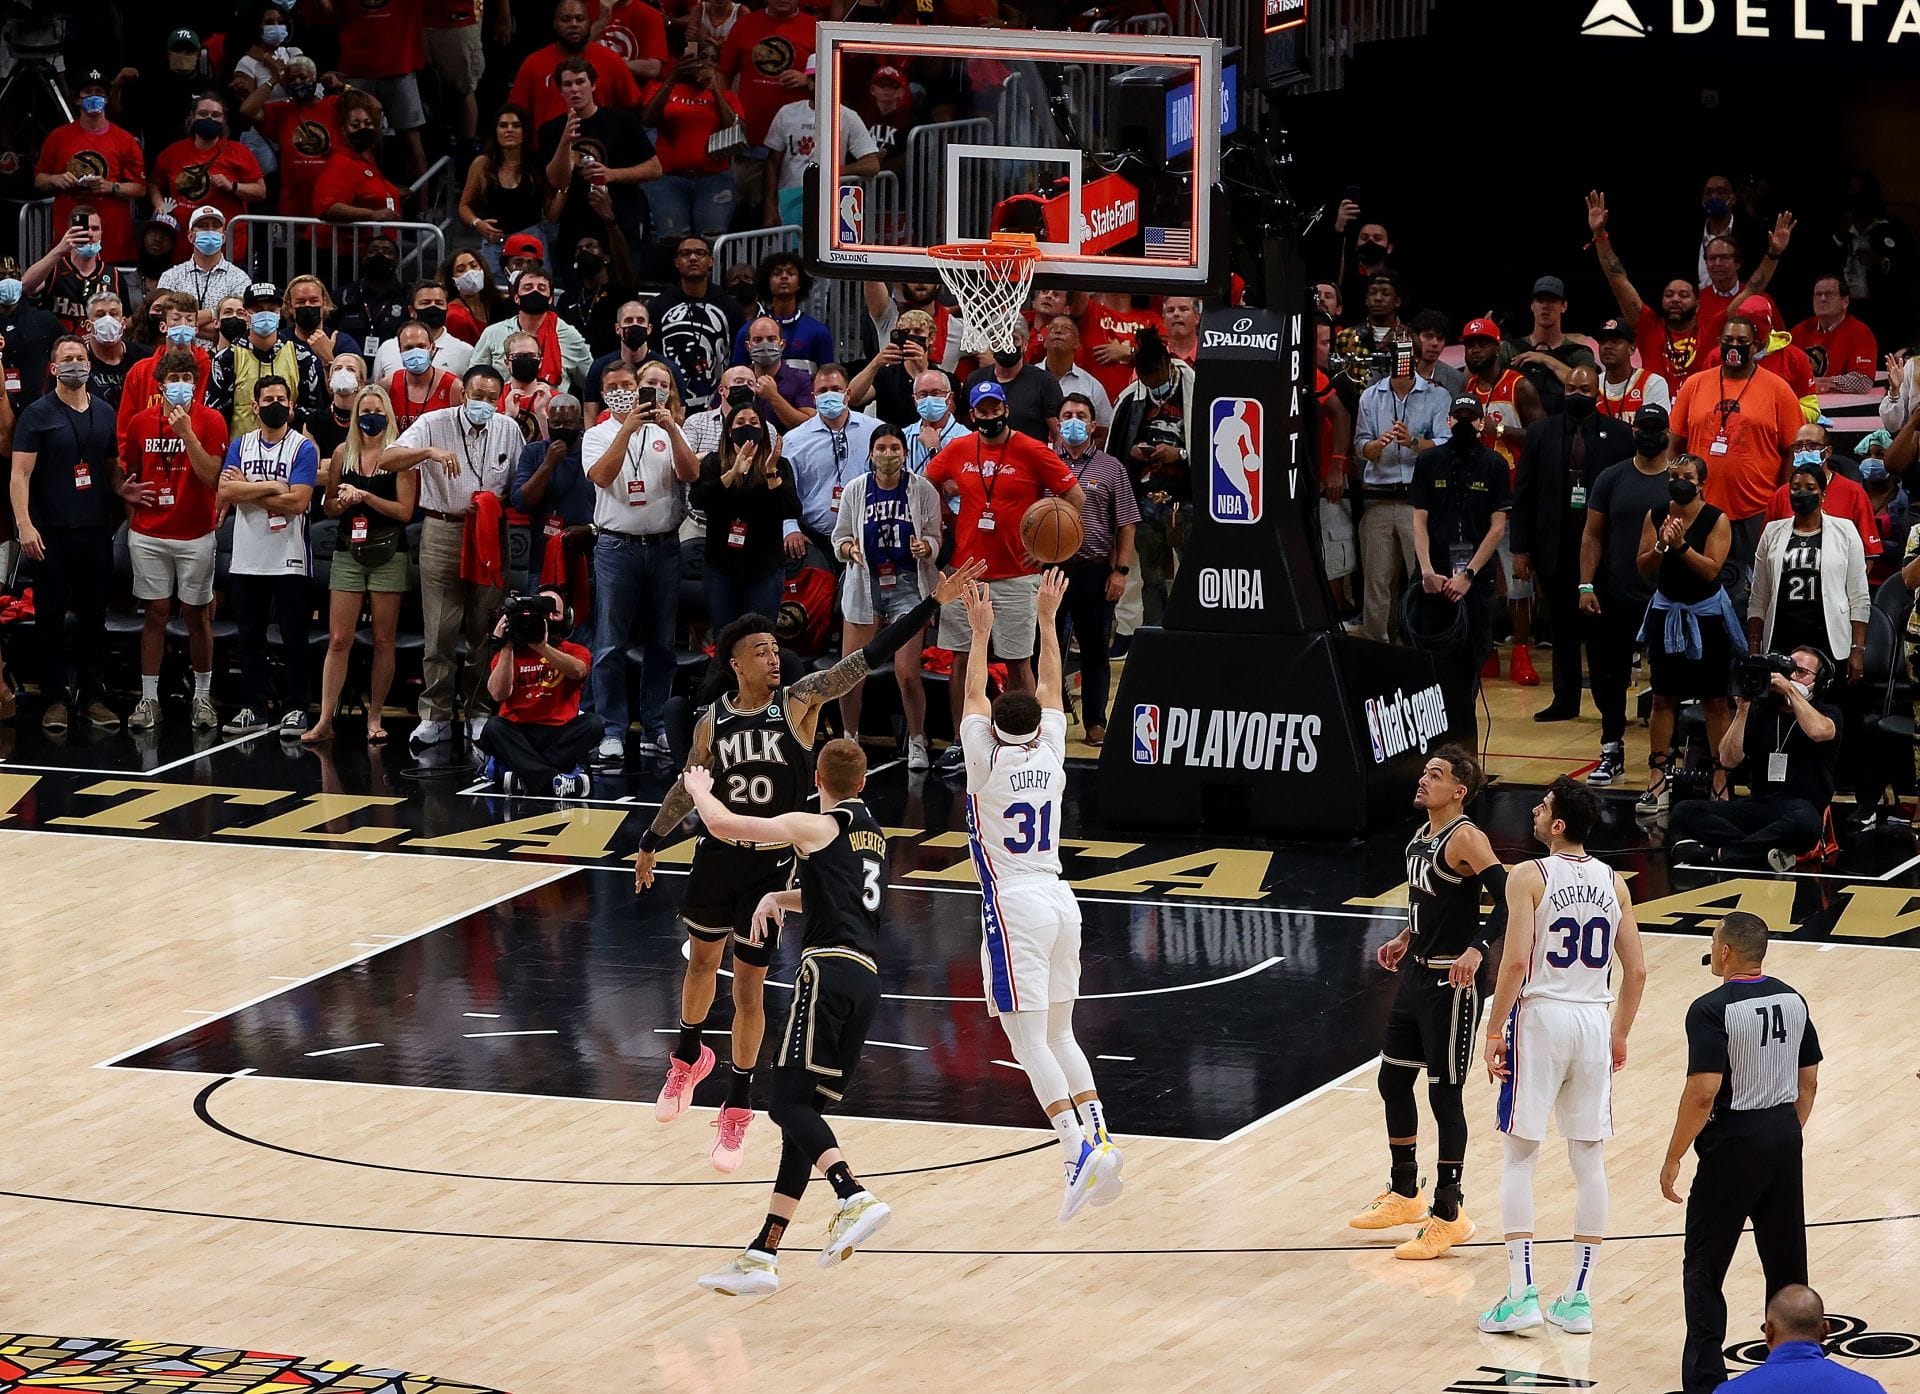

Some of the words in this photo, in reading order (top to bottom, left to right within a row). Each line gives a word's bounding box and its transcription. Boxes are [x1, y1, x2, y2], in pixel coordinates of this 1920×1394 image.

[1672, 0, 1920, 43] DELTA
[841, 232, 854, 241] NBA
[830, 253, 868, 263] SPALDING
[1203, 330, 1278, 351] SPALDING
[1455, 397, 1476, 405] CREW
[243, 460, 287, 479] PHILA
[1217, 494, 1242, 515] NBA
[878, 523, 901, 548] 21
[1199, 567, 1265, 610] @NBA
[1788, 576, 1815, 601] 21
[1376, 687, 1417, 758] that's
[1411, 683, 1449, 755] game
[717, 729, 789, 773] MLK
[1162, 707, 1321, 773] PLAYOFFS
[727, 774, 774, 804] 20
[1009, 769, 1052, 792] CURRY
[1002, 800, 1052, 854] 31
[848, 830, 887, 861] HUERTER
[862, 858, 881, 912] 3
[1549, 884, 1615, 914] KORKMAZ
[1545, 916, 1612, 969] 30
[1755, 1003, 1787, 1048] 74
